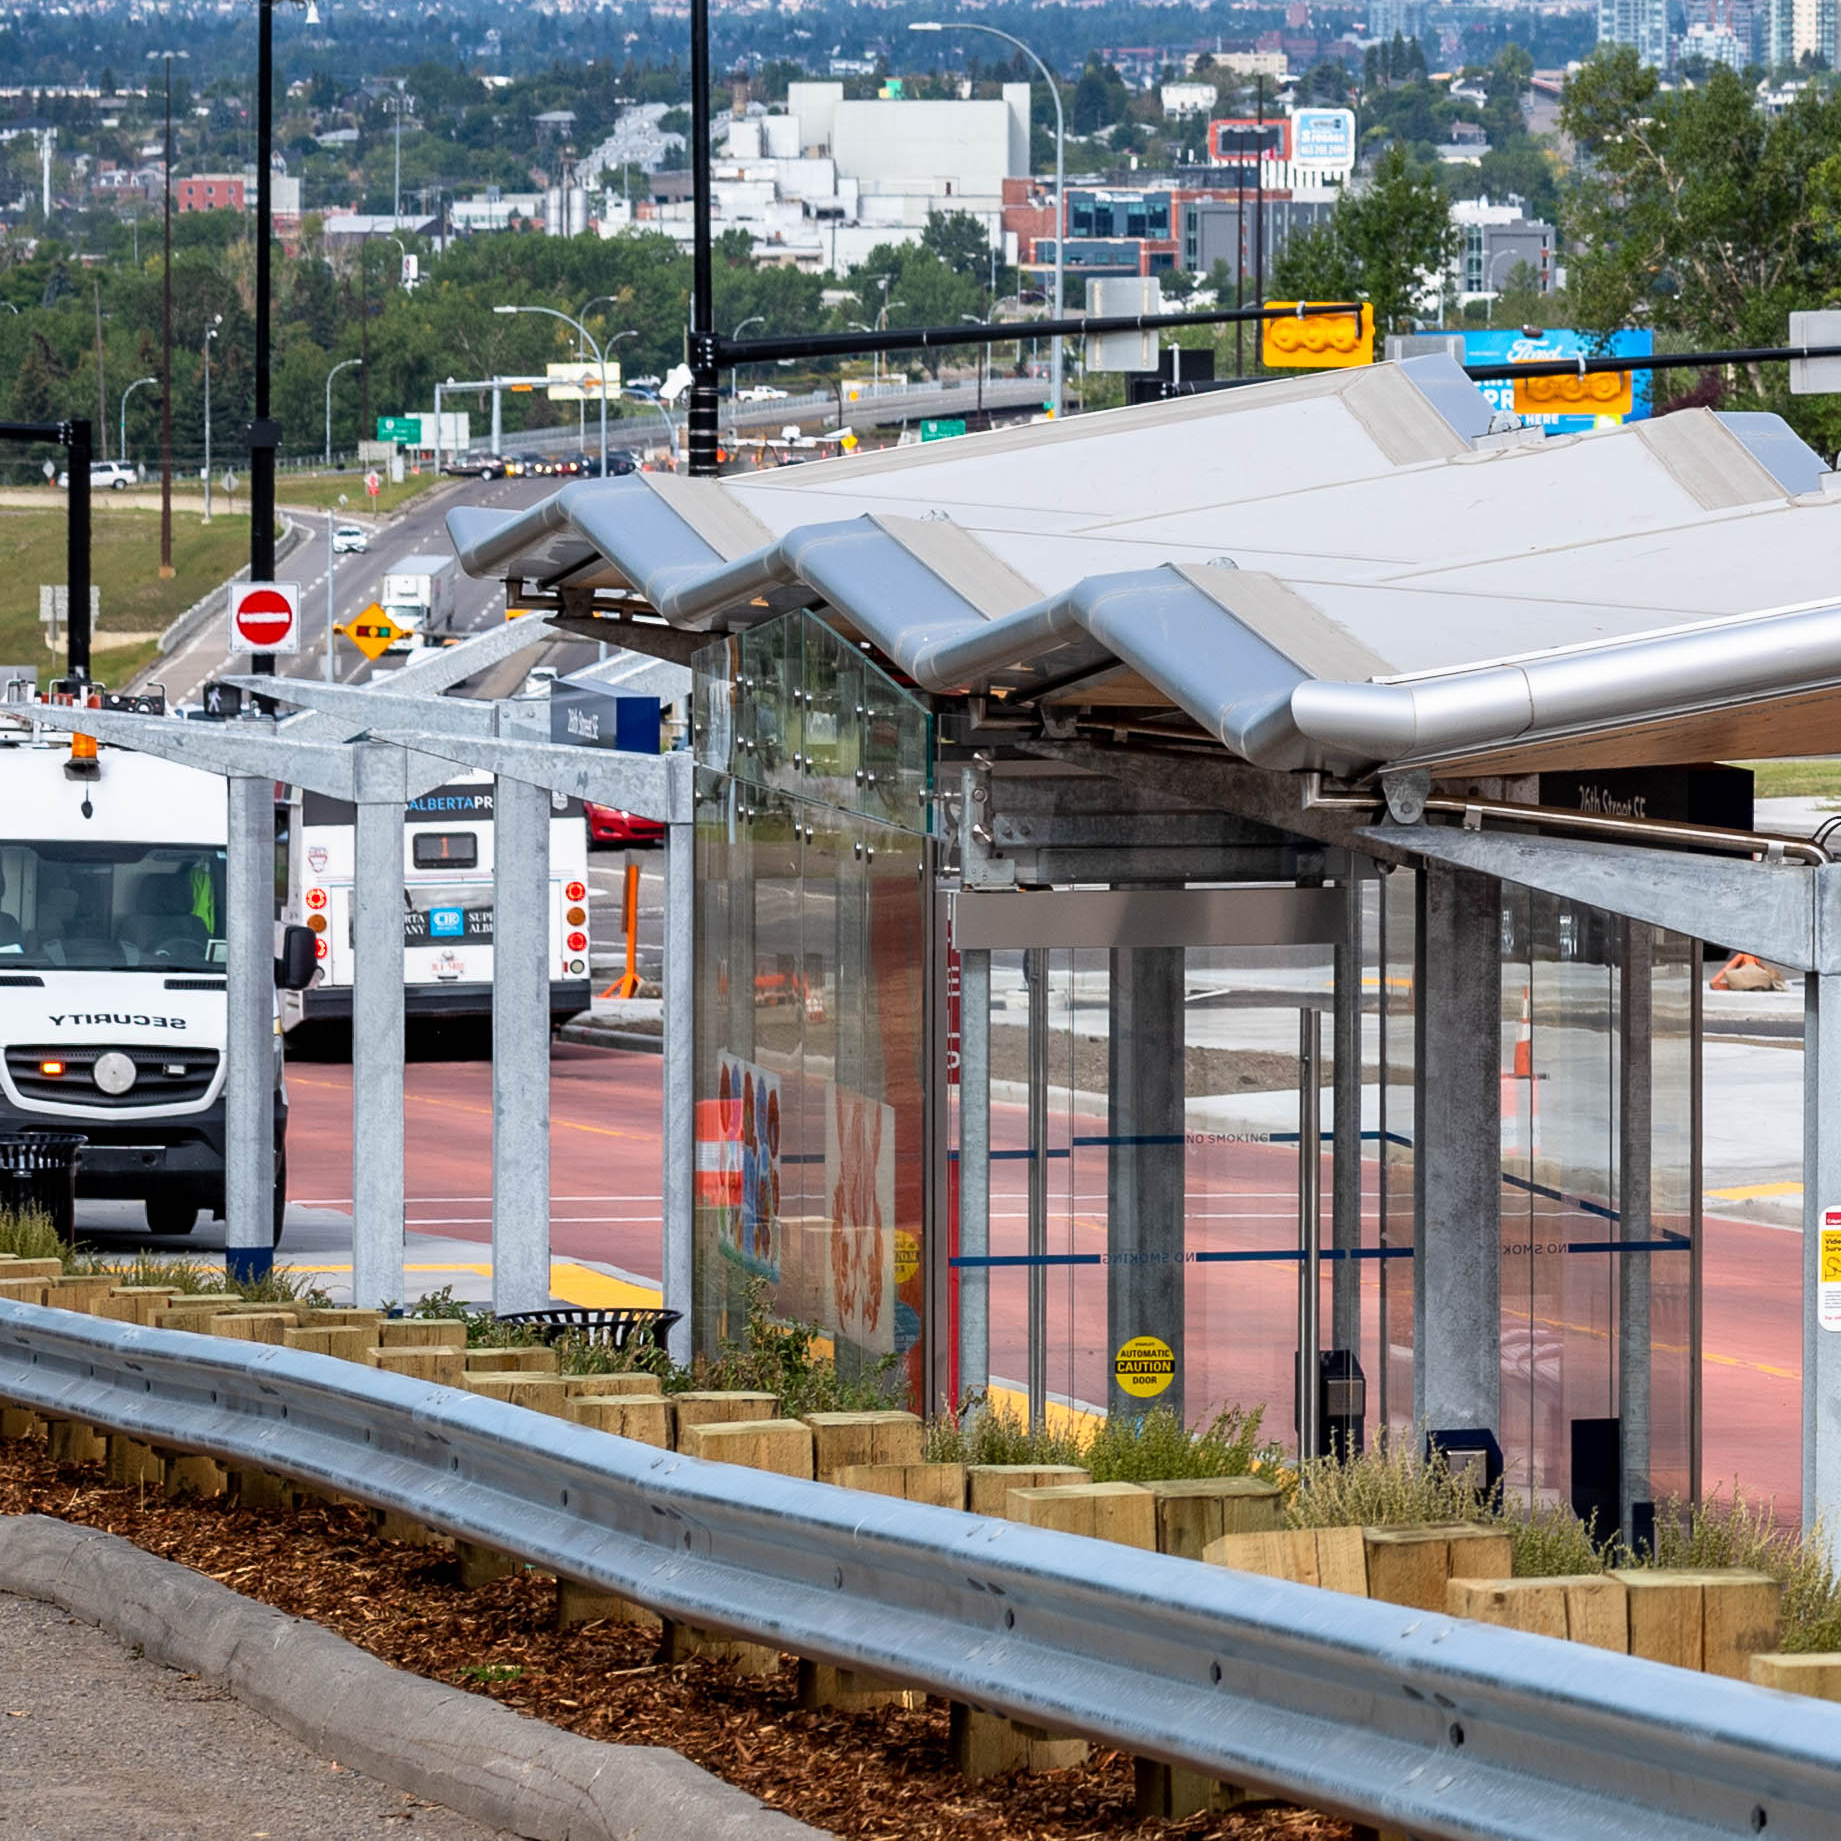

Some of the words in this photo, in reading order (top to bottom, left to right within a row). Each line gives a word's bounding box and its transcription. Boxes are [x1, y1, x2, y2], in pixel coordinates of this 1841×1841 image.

[1506, 339, 1564, 362] Ford
[1602, 788, 1633, 816] Street
[1186, 1134, 1204, 1144] NO
[1207, 1133, 1269, 1144] SMOKING
[1120, 1349, 1171, 1358] AUTOMATIC
[1116, 1361, 1172, 1373] CAUTION
[1132, 1376, 1158, 1385] DOOR
